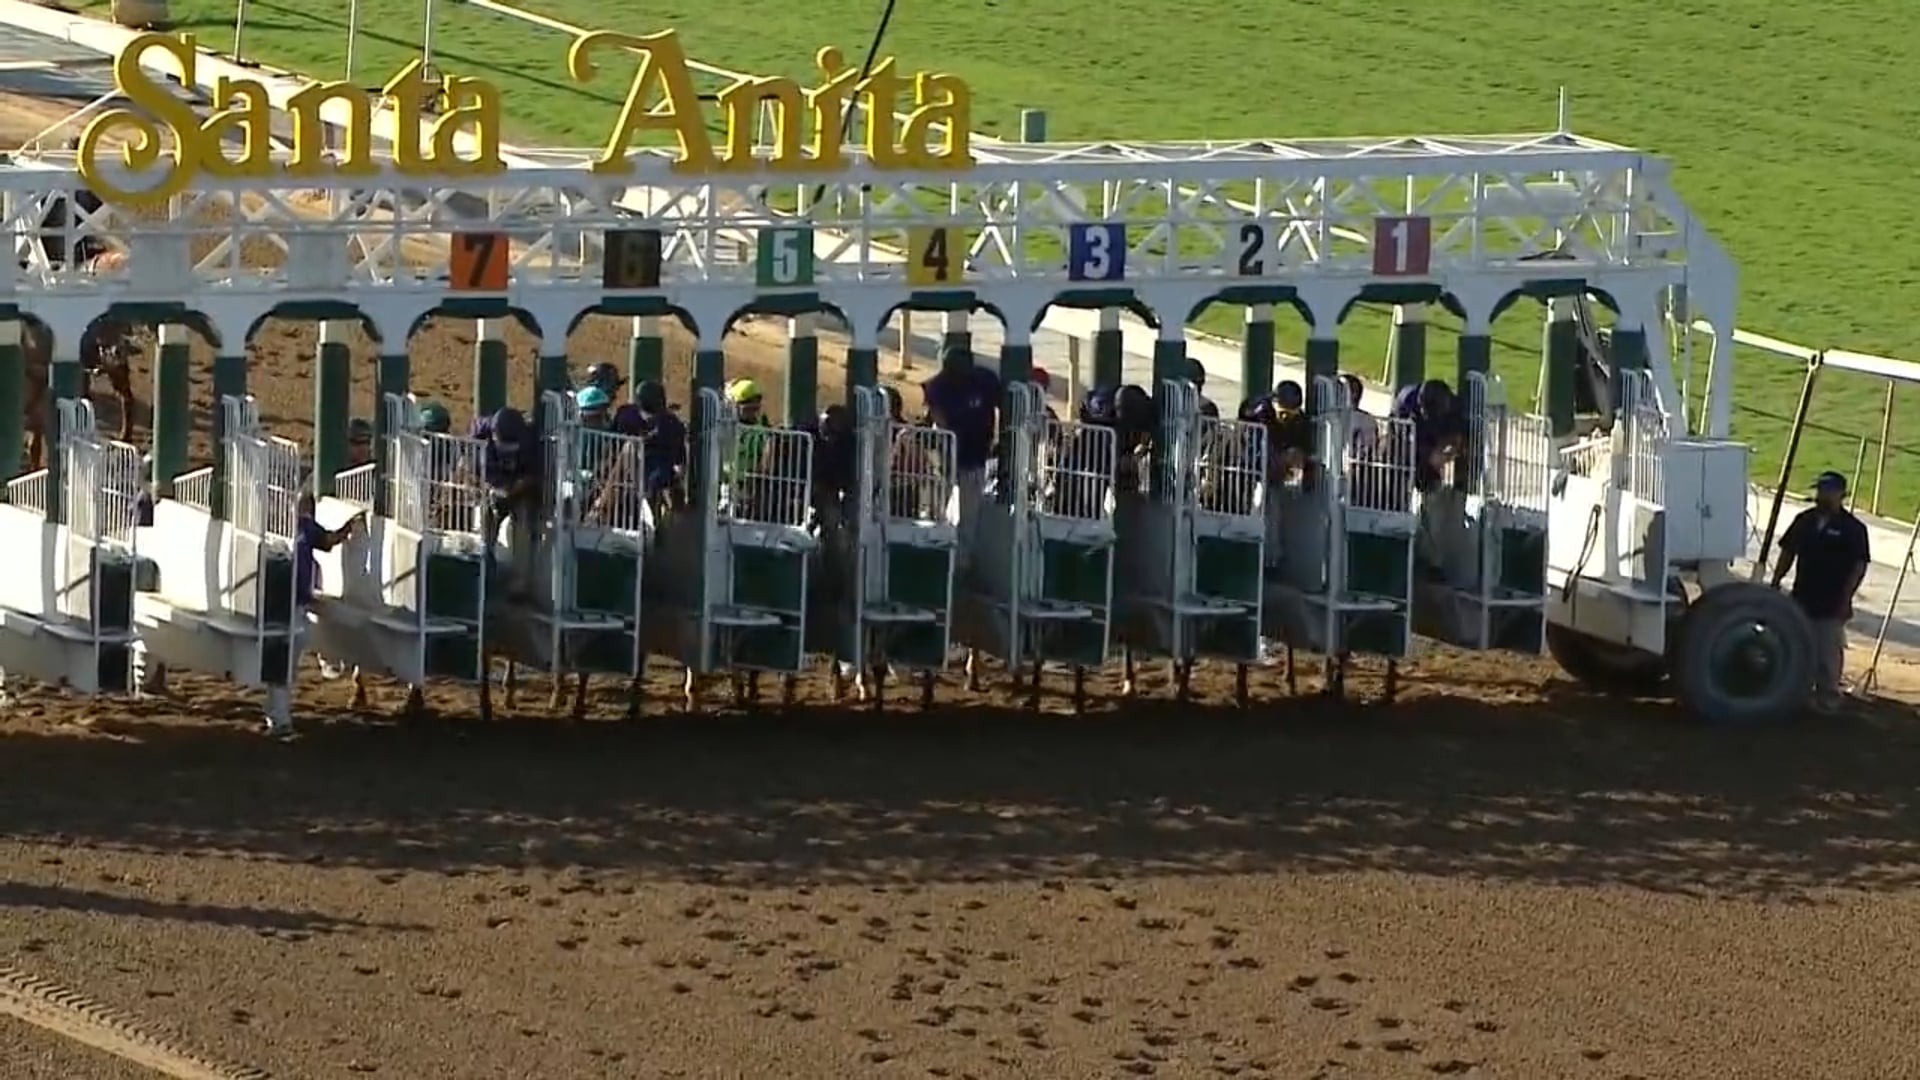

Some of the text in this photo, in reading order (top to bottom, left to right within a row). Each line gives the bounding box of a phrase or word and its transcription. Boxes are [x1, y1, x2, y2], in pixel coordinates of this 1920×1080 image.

[78, 28, 976, 205] Santa Anita
[464, 234, 494, 287] 7
[618, 234, 645, 286] 6
[771, 231, 797, 285] 5
[923, 228, 948, 281] 4
[1085, 225, 1110, 280] 3
[1239, 224, 1263, 276] 2
[1391, 221, 1409, 272] 1
